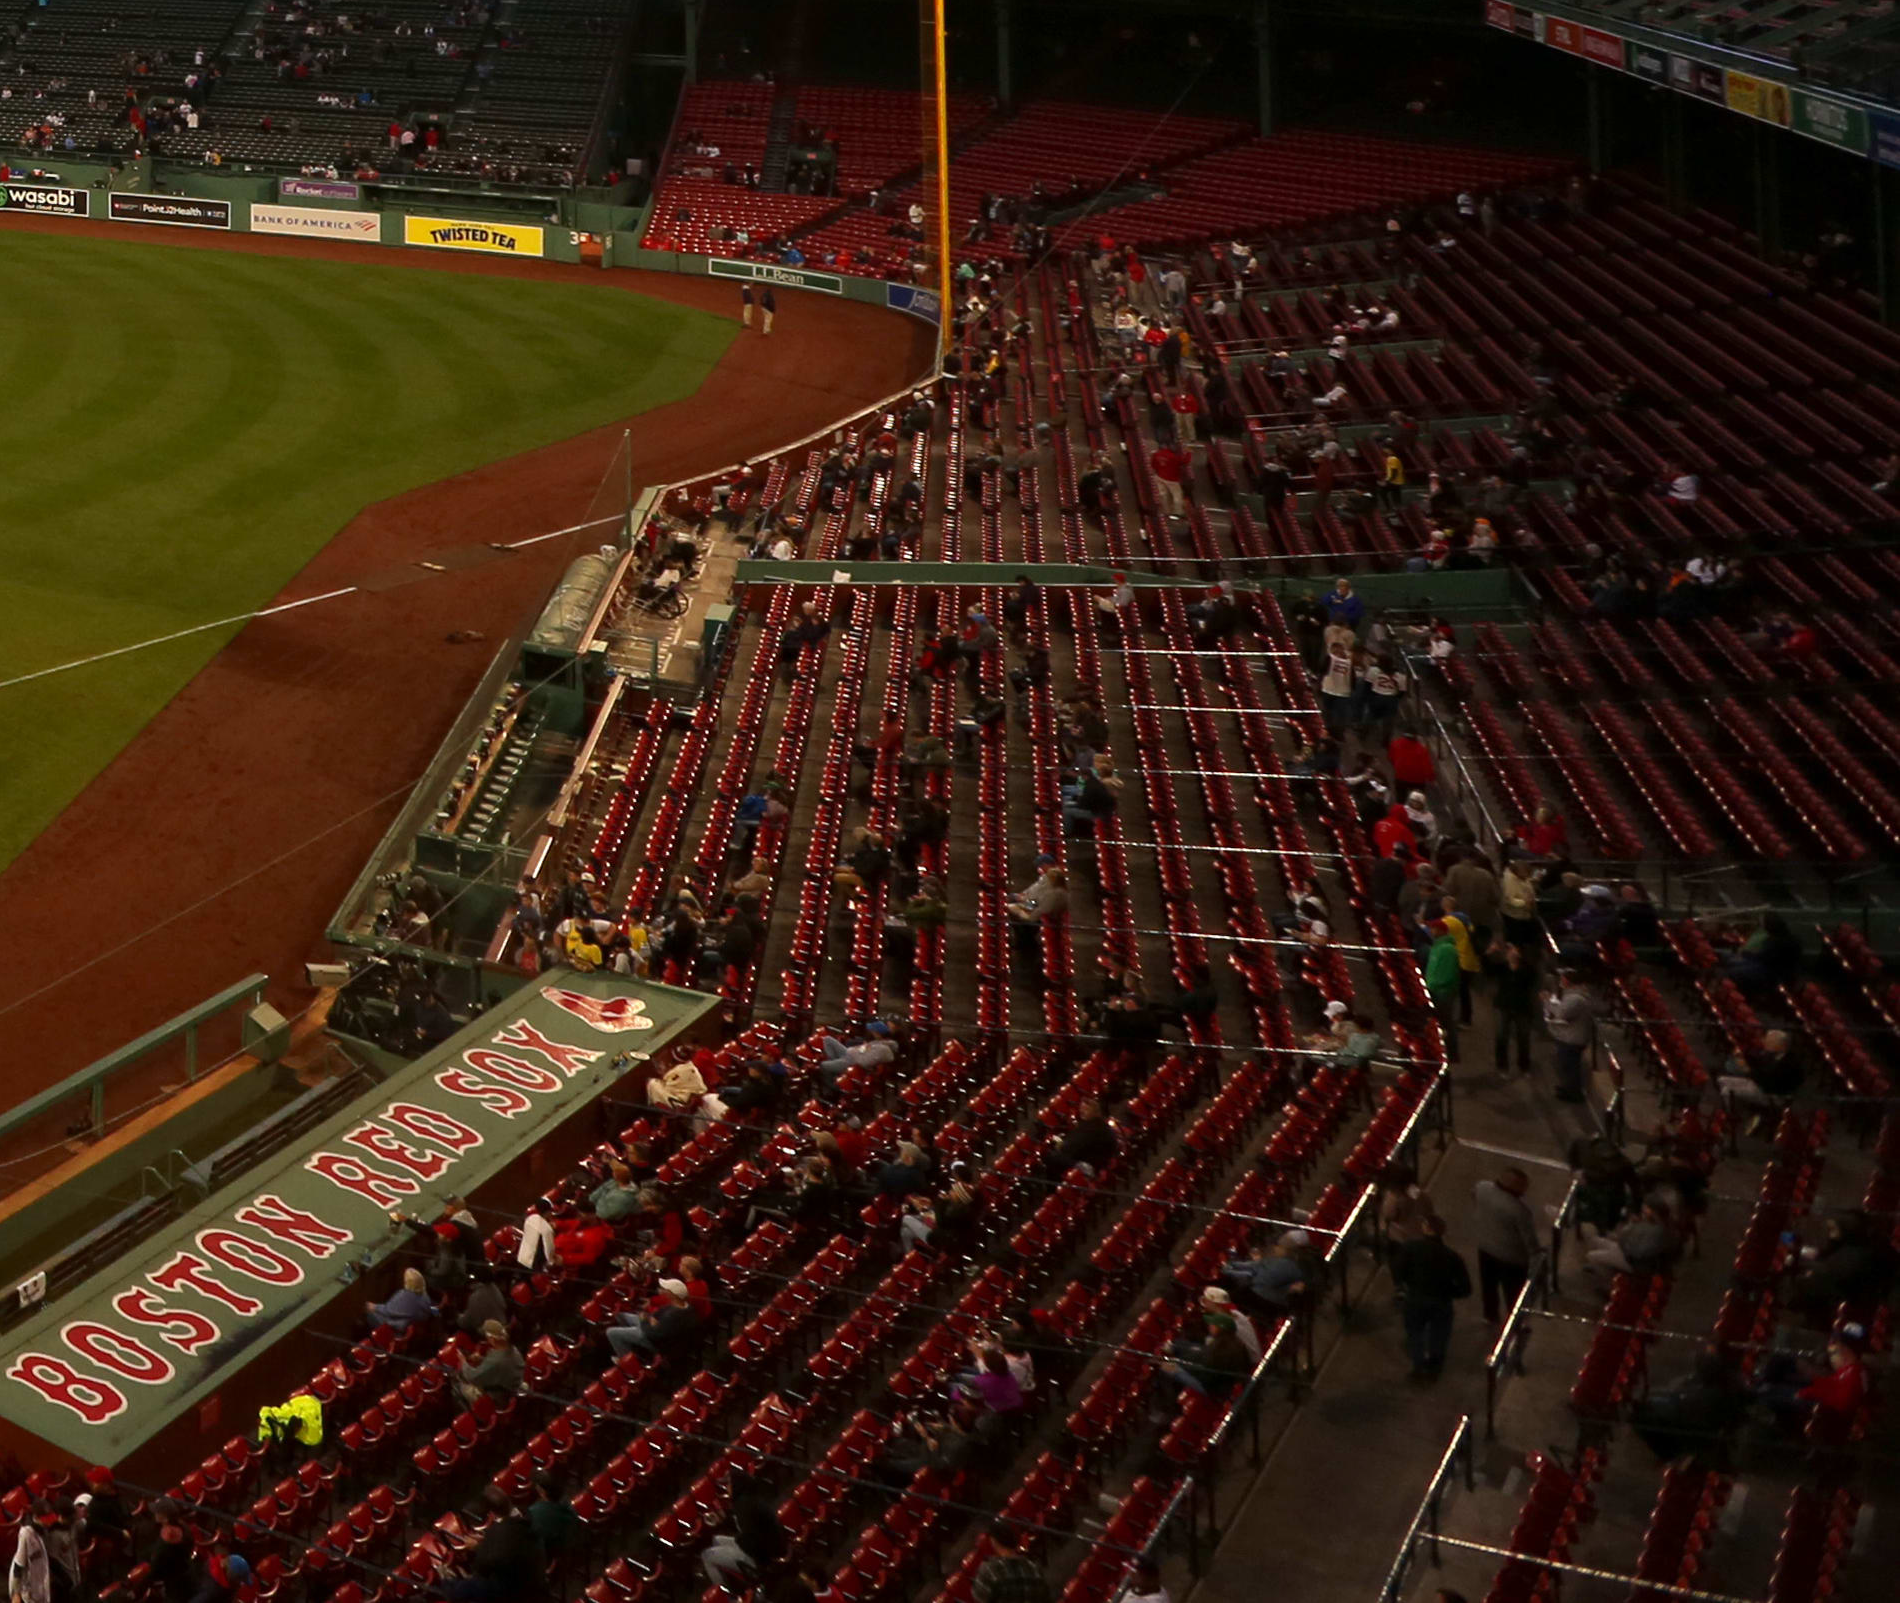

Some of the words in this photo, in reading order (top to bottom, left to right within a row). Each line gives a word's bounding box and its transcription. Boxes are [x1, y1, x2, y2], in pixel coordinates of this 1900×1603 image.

[8, 187, 75, 208] wasabi
[254, 215, 284, 226] BANK
[287, 217, 299, 227] OF
[303, 219, 353, 230] AMERICA
[430, 226, 489, 244] TWISTED
[491, 232, 517, 250] TEA
[5, 1193, 355, 1426] BOSTON
[304, 1102, 484, 1210] RED
[434, 1018, 606, 1121] SOX
